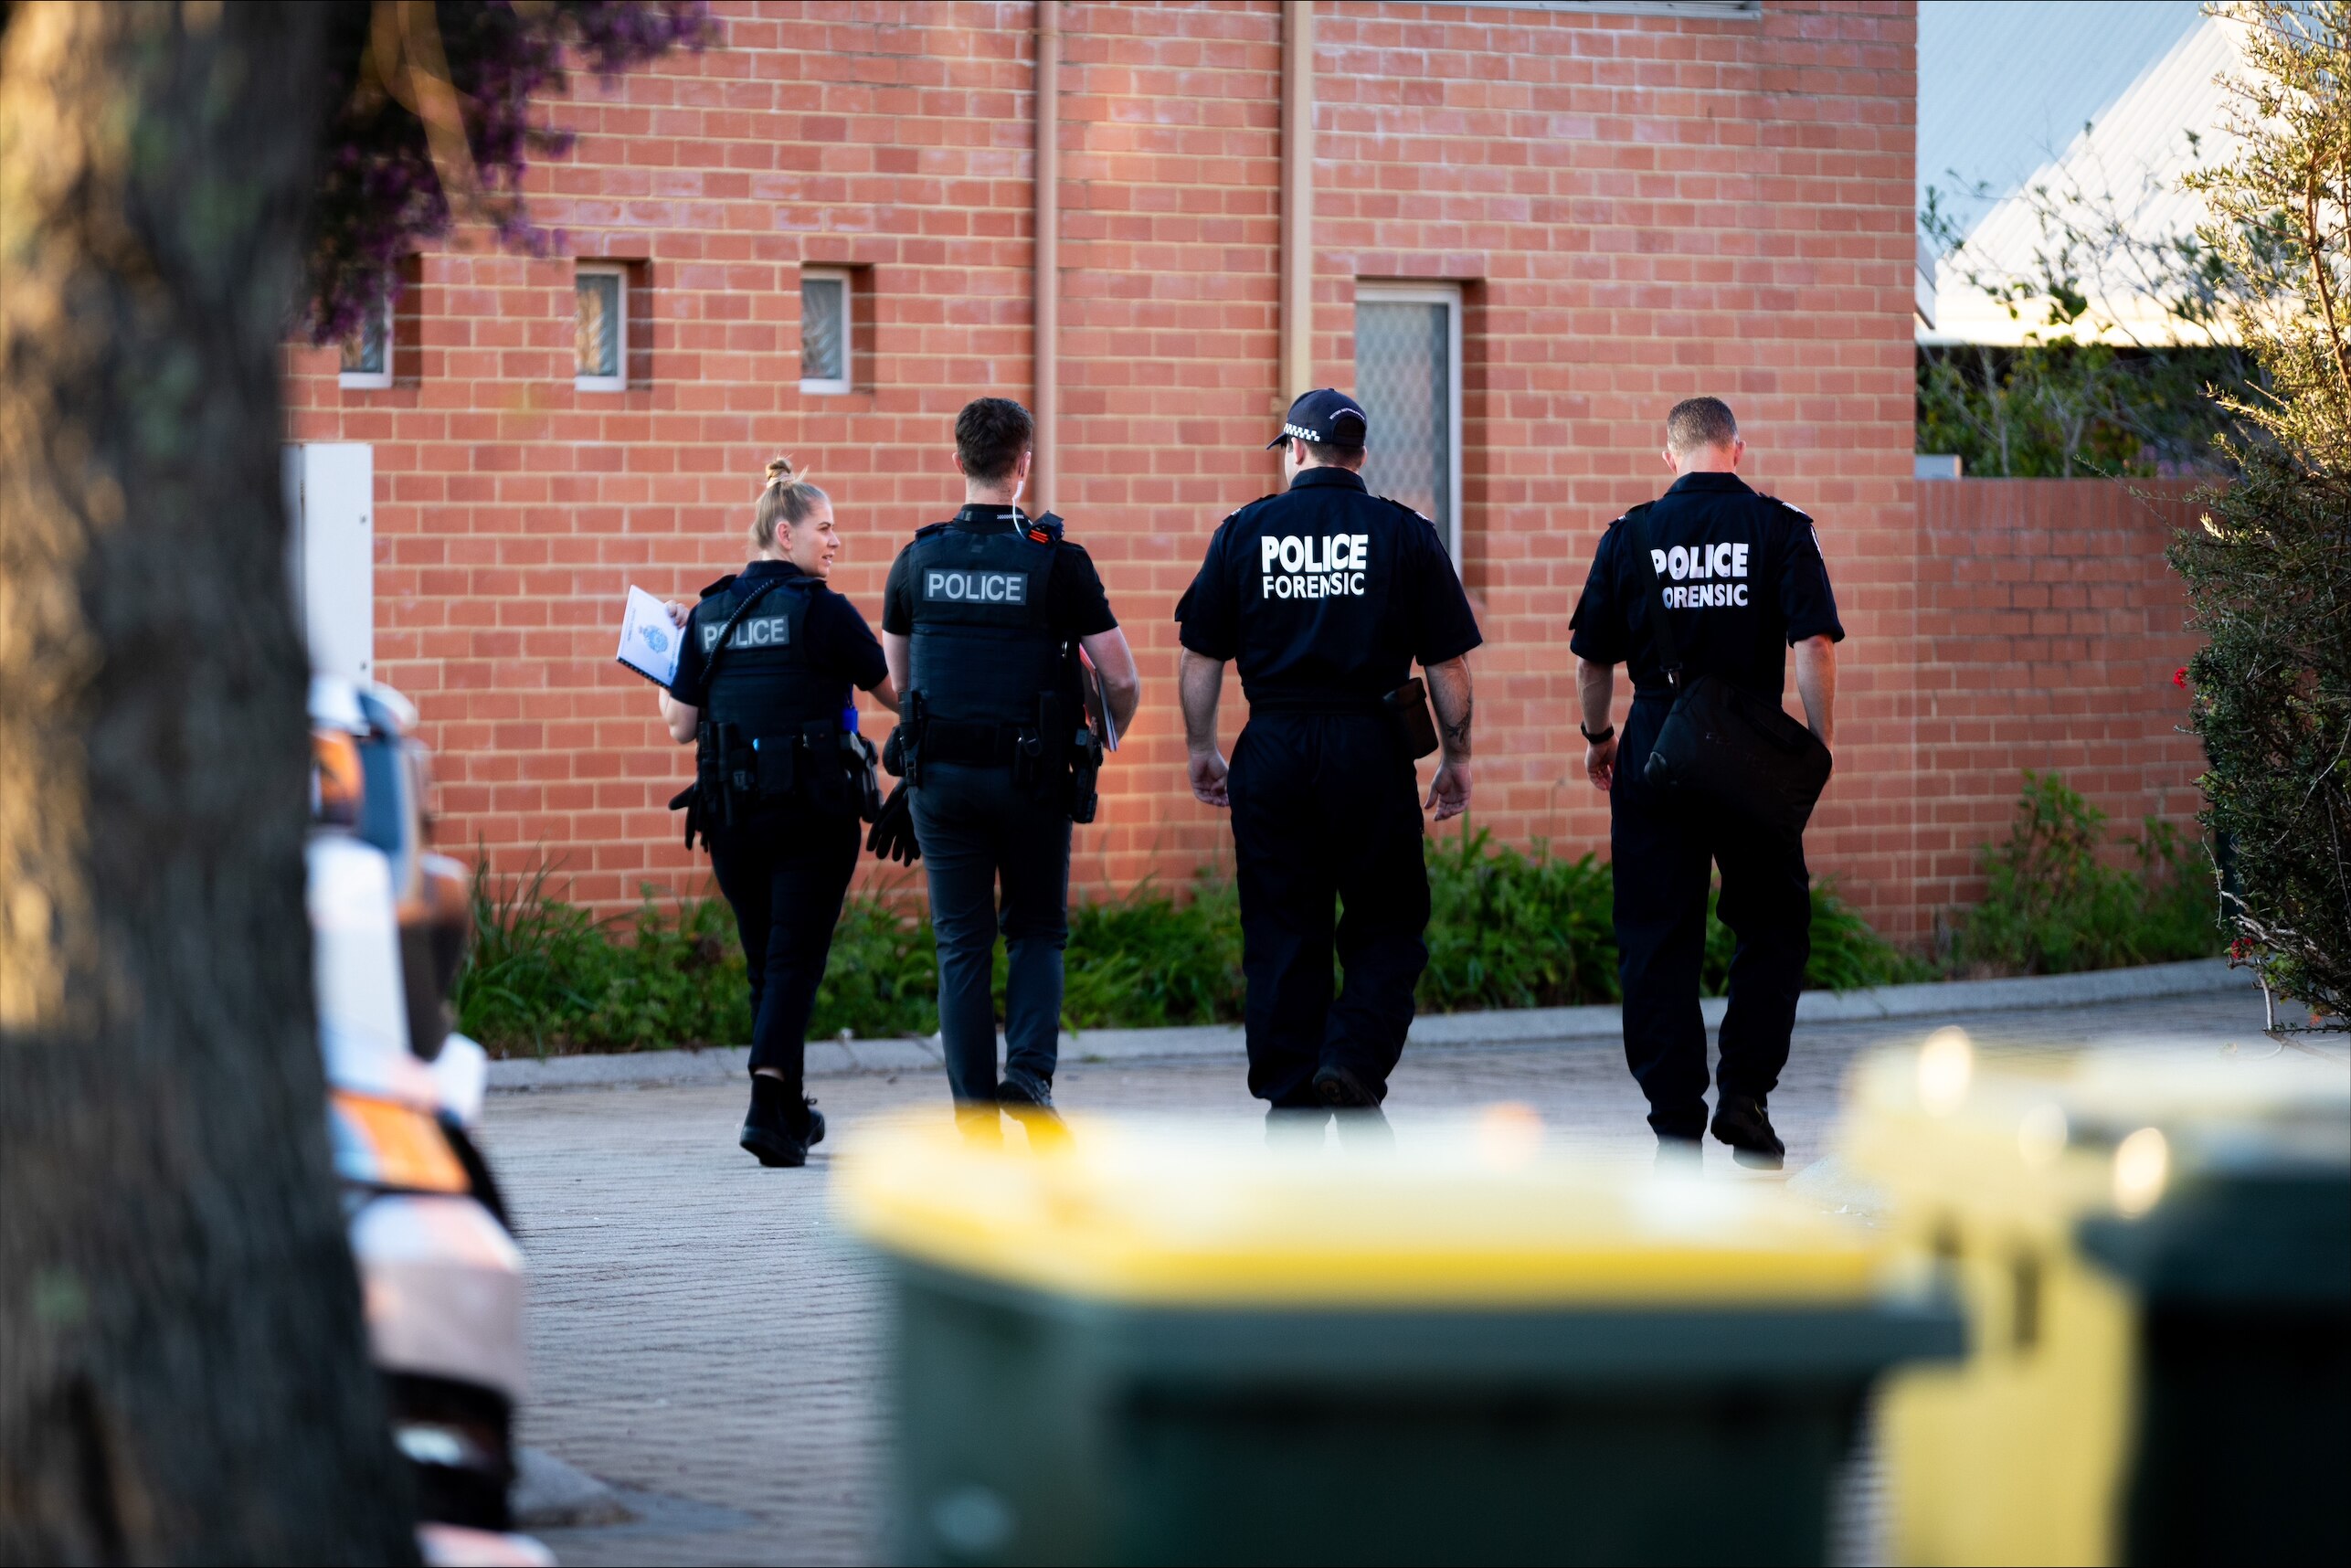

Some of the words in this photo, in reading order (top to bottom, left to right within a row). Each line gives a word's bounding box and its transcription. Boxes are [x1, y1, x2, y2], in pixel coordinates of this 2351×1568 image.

[1262, 534, 1369, 573] POLICE
[1650, 543, 1749, 580] POLICE
[928, 573, 1022, 601] POLICE
[1263, 572, 1365, 599] FORENSIC
[1662, 583, 1749, 609] ORENSIC
